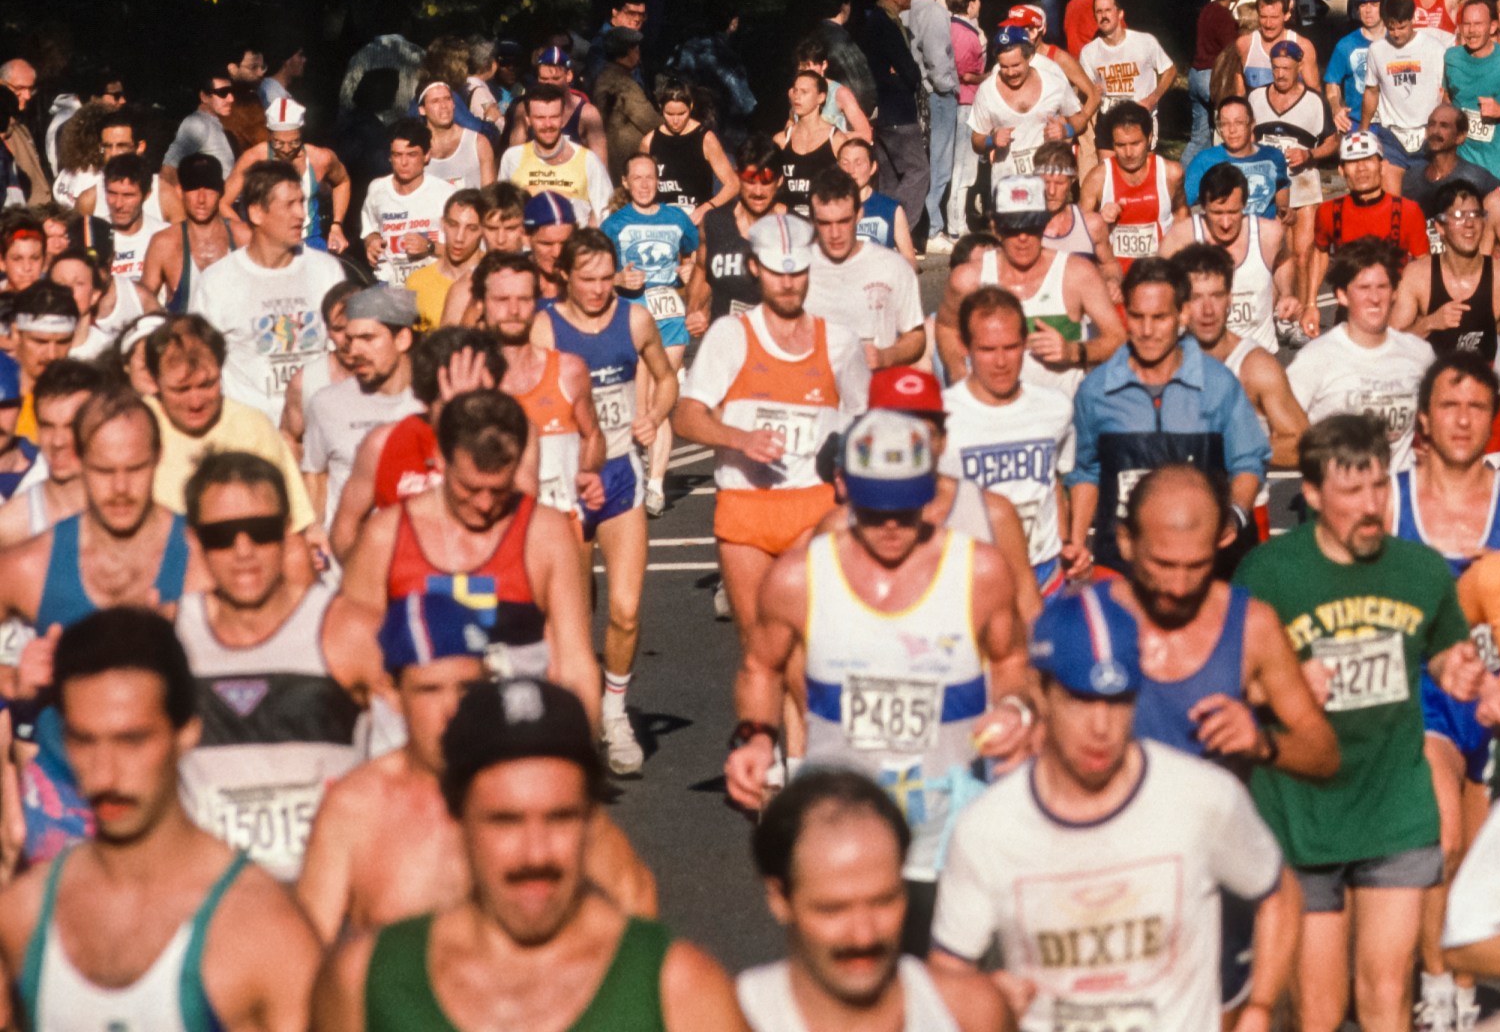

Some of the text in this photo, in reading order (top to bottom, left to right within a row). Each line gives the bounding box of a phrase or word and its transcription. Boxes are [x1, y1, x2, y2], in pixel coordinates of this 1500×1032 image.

[1096, 61, 1140, 79] FLORIDA
[1393, 72, 1417, 86] TEAM
[1105, 78, 1135, 93] STATE
[529, 170, 556, 179] schuh
[529, 179, 574, 188] schneider
[657, 180, 682, 192] GIRL
[382, 222, 407, 233] SPORT
[1115, 233, 1152, 253] 19367
[1227, 303, 1252, 323] 50
[1315, 596, 1425, 638] VINCENT
[1332, 652, 1391, 696] 4277
[848, 695, 925, 740] P485
[1036, 914, 1163, 970] DIXIE
